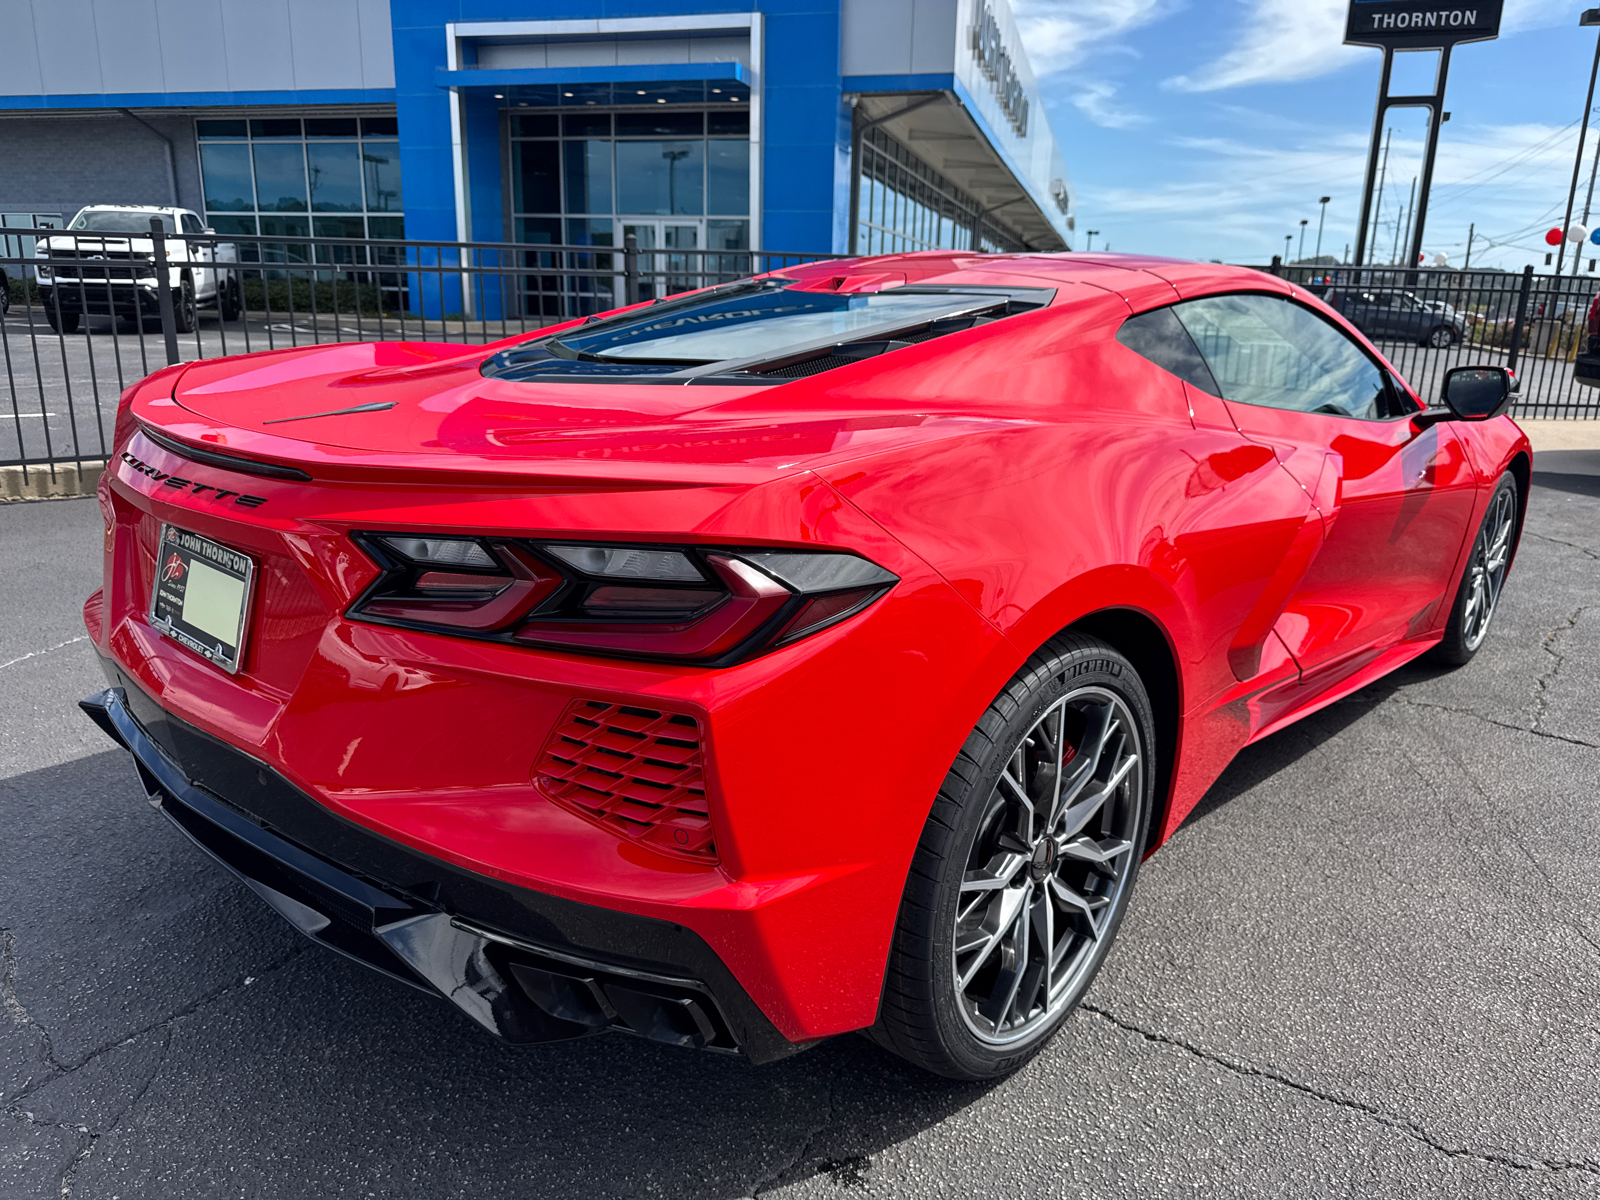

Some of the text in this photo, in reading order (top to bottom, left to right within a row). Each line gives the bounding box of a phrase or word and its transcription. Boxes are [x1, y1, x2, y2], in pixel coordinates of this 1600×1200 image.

[1371, 10, 1477, 29] THORNTON
[119, 452, 268, 508] CORVETTE
[180, 534, 247, 574] JOHN THORNTON
[178, 634, 204, 654] CHEVROLET
[1064, 660, 1121, 682] MICHELIN
